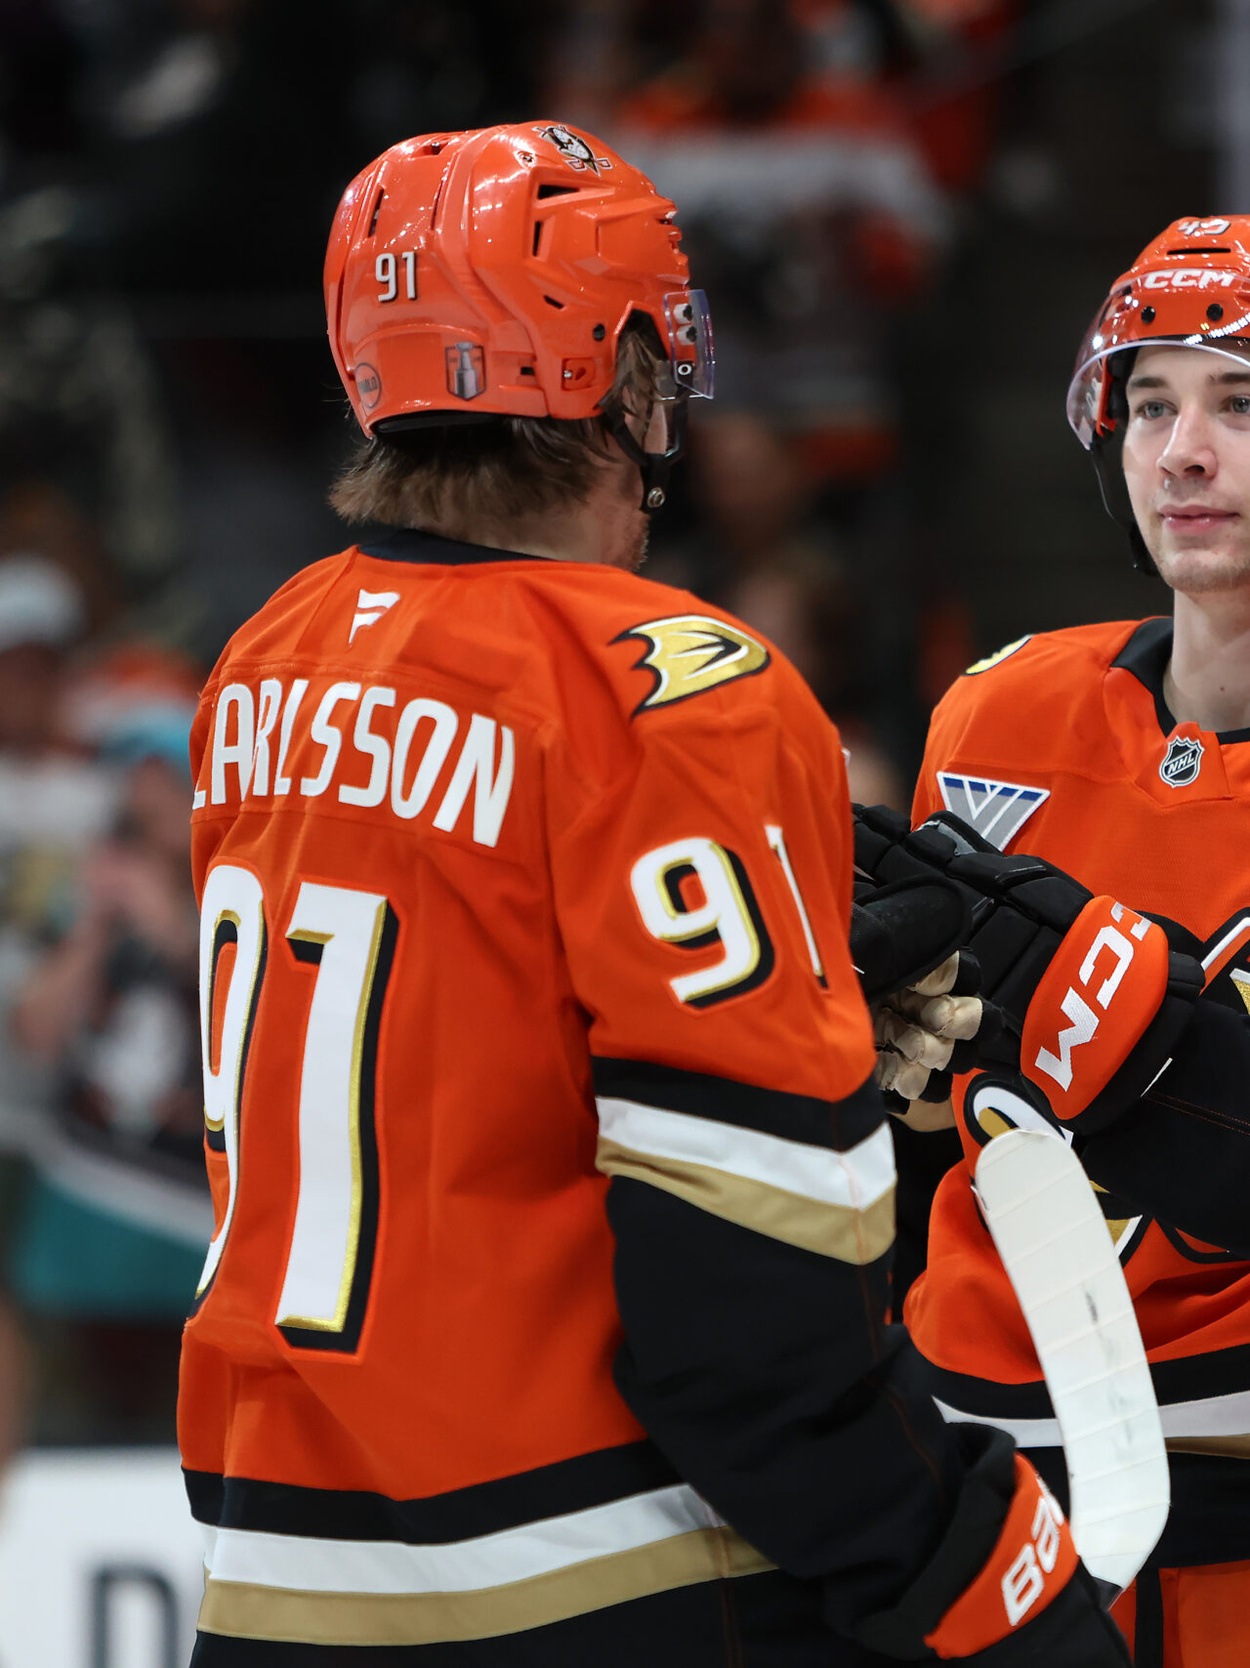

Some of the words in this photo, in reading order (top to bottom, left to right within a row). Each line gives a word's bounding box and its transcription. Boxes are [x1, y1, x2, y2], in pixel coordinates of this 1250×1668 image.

[375, 251, 417, 303] 91
[1143, 268, 1237, 289] CCM
[192, 679, 516, 848] ARLSSON
[1167, 752, 1195, 775] NHL
[629, 824, 829, 1011] 91
[190, 864, 400, 1354] 91
